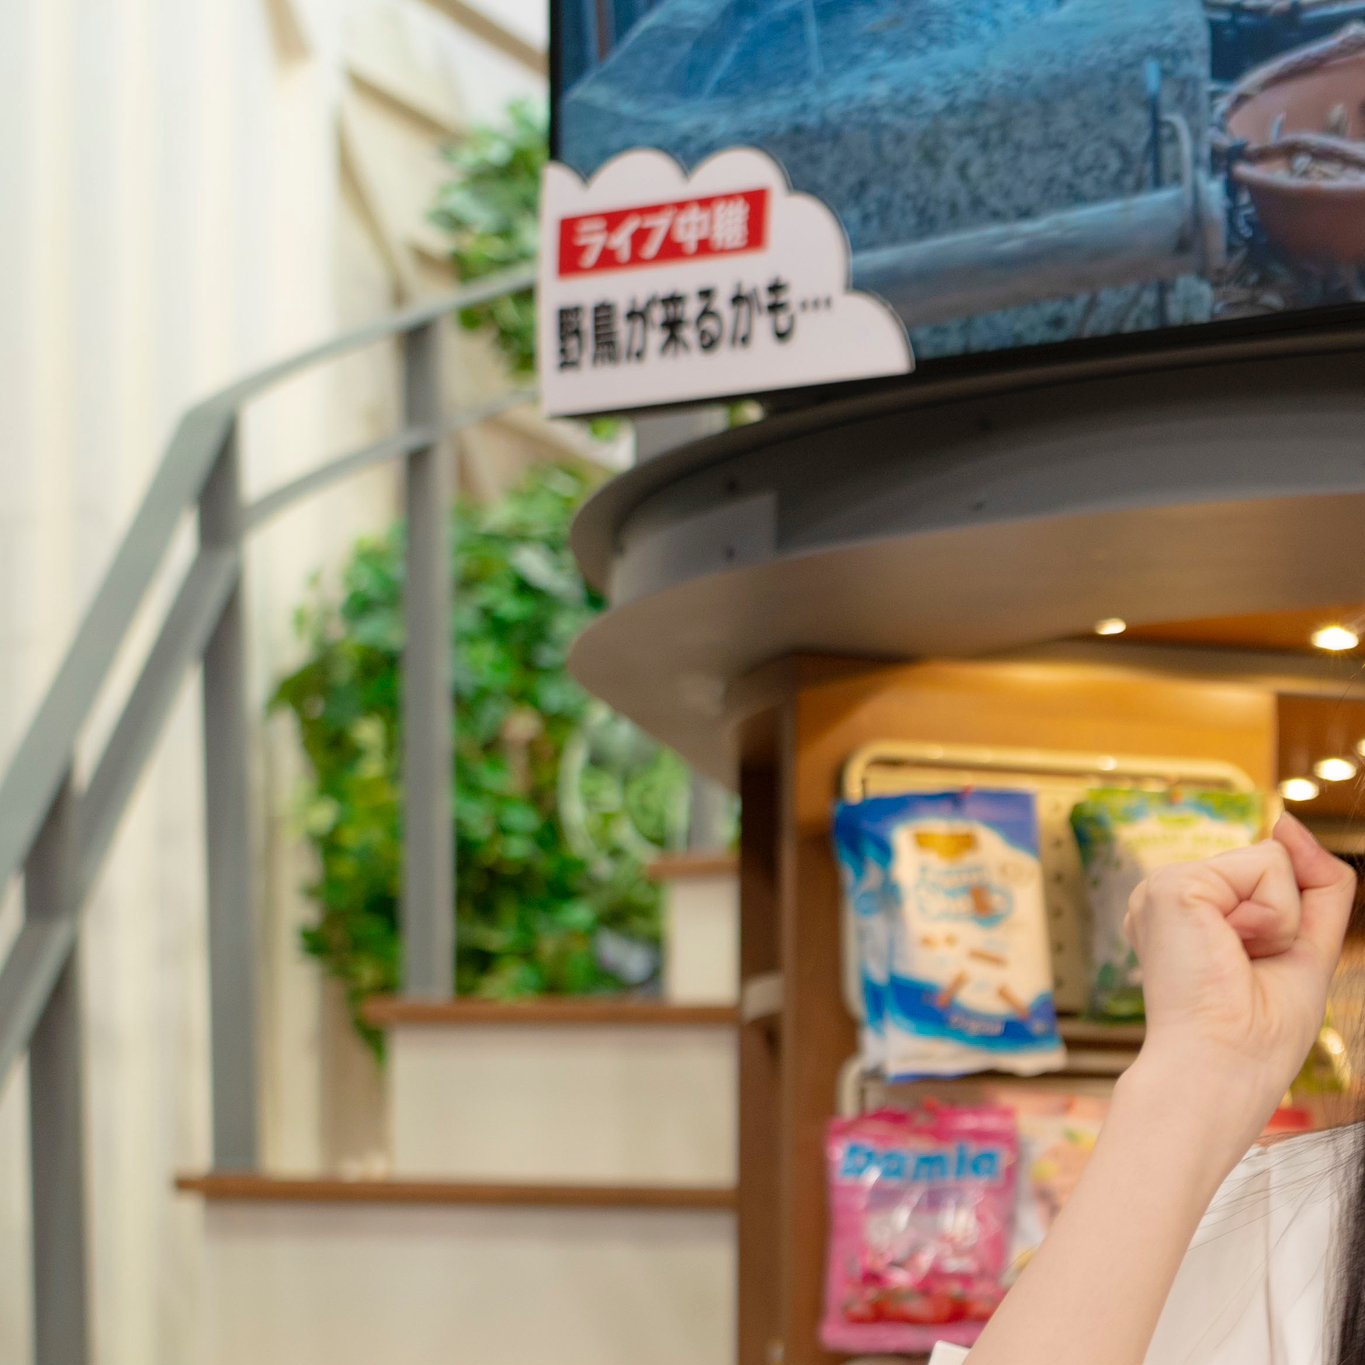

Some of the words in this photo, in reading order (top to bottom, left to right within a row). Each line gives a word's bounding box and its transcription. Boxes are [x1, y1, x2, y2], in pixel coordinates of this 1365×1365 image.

[571, 196, 751, 268] ライブ中継
[840, 1143, 1003, 1182] Damla
